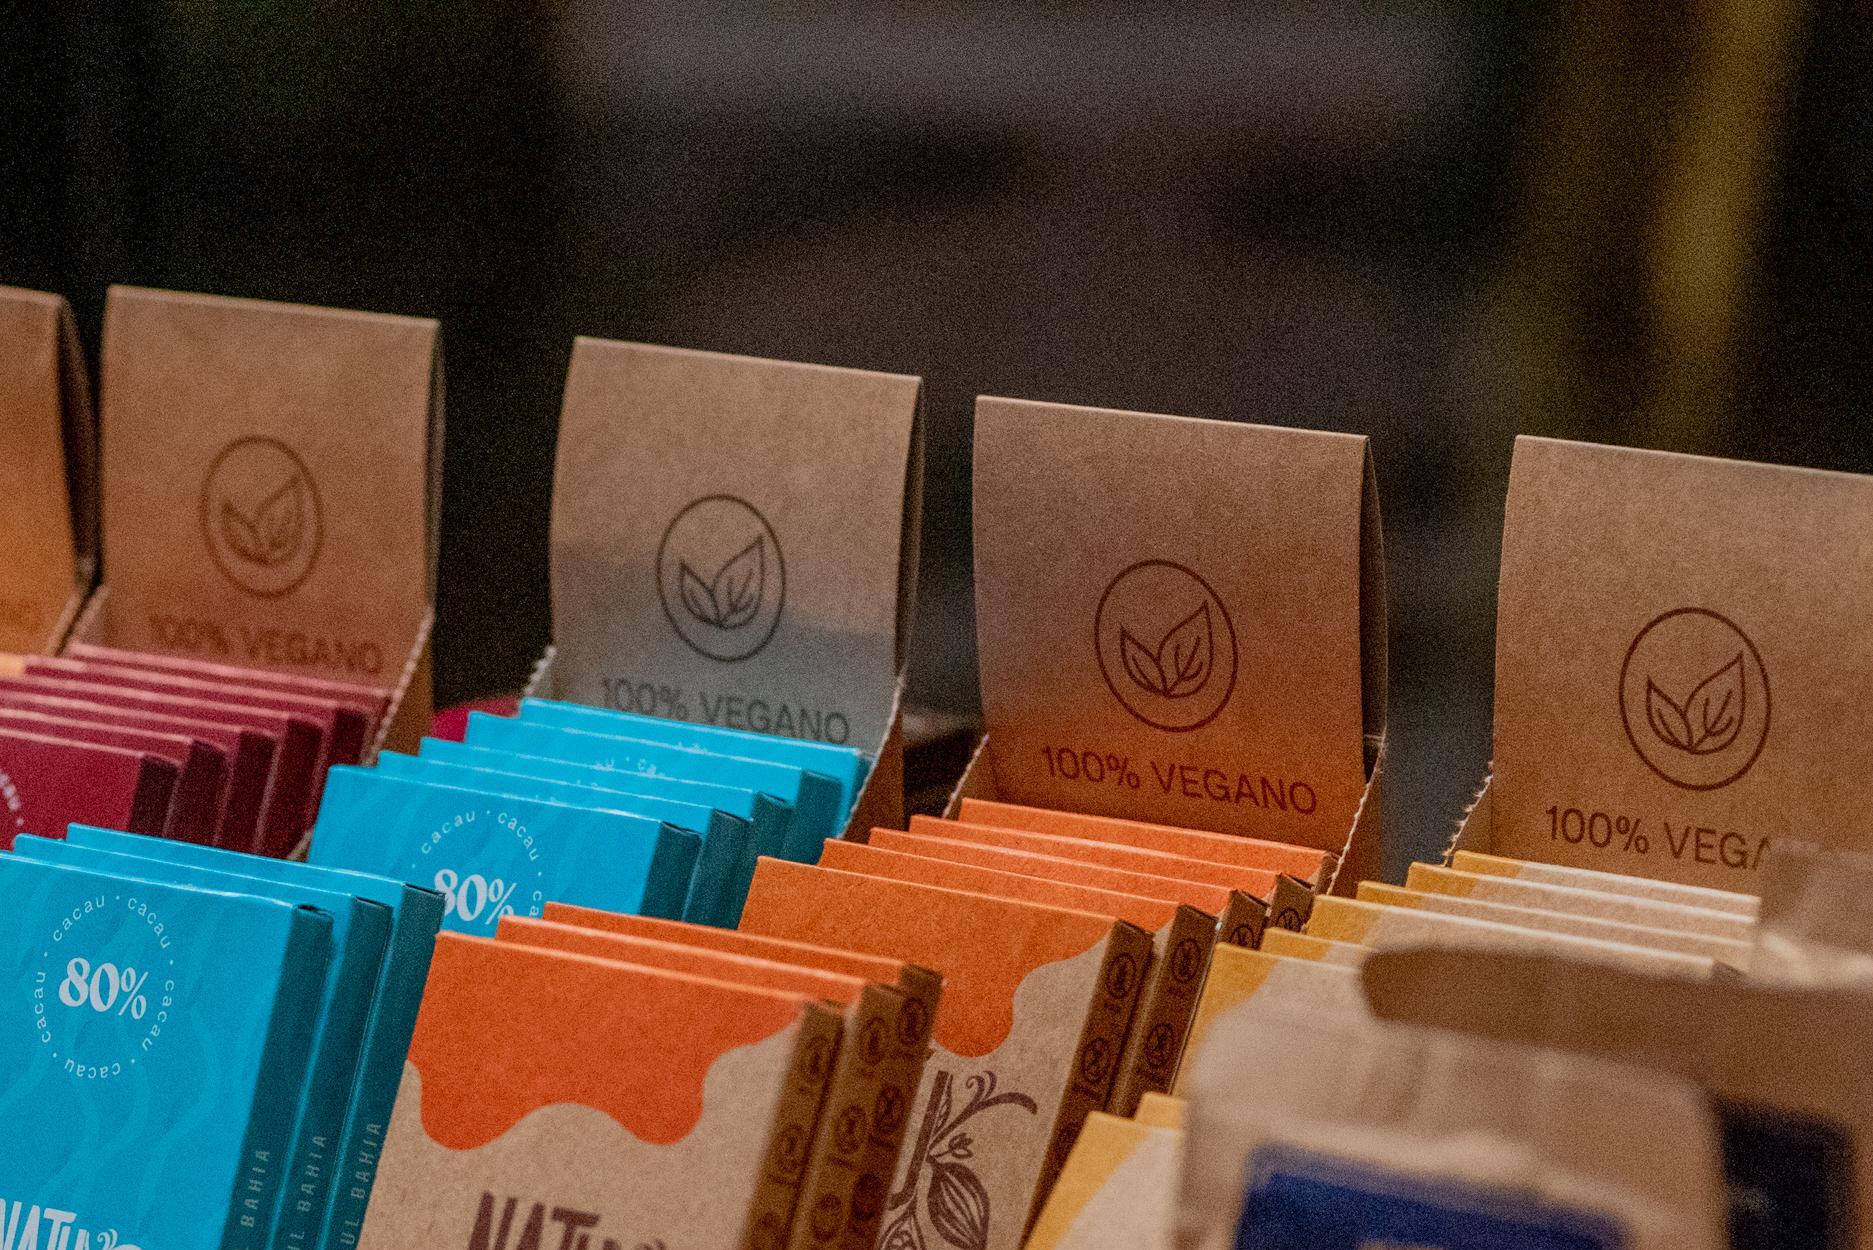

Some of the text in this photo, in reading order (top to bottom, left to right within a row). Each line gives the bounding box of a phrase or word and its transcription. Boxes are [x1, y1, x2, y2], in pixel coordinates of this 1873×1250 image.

[242, 624, 383, 676] VEGANO
[600, 675, 852, 745] 100% VEGANO
[1042, 745, 1318, 816] 100% VEGANO
[421, 808, 541, 863] cacau cacau
[1544, 804, 1650, 855] 100%
[434, 868, 519, 926] 80%
[33, 895, 176, 1080] cacau cacau cacau cacau cacau
[57, 956, 150, 1020] 80%
[240, 1149, 271, 1229] BAHIA
[296, 1134, 328, 1214] BAHIA
[350, 1121, 383, 1201] BAHIA
